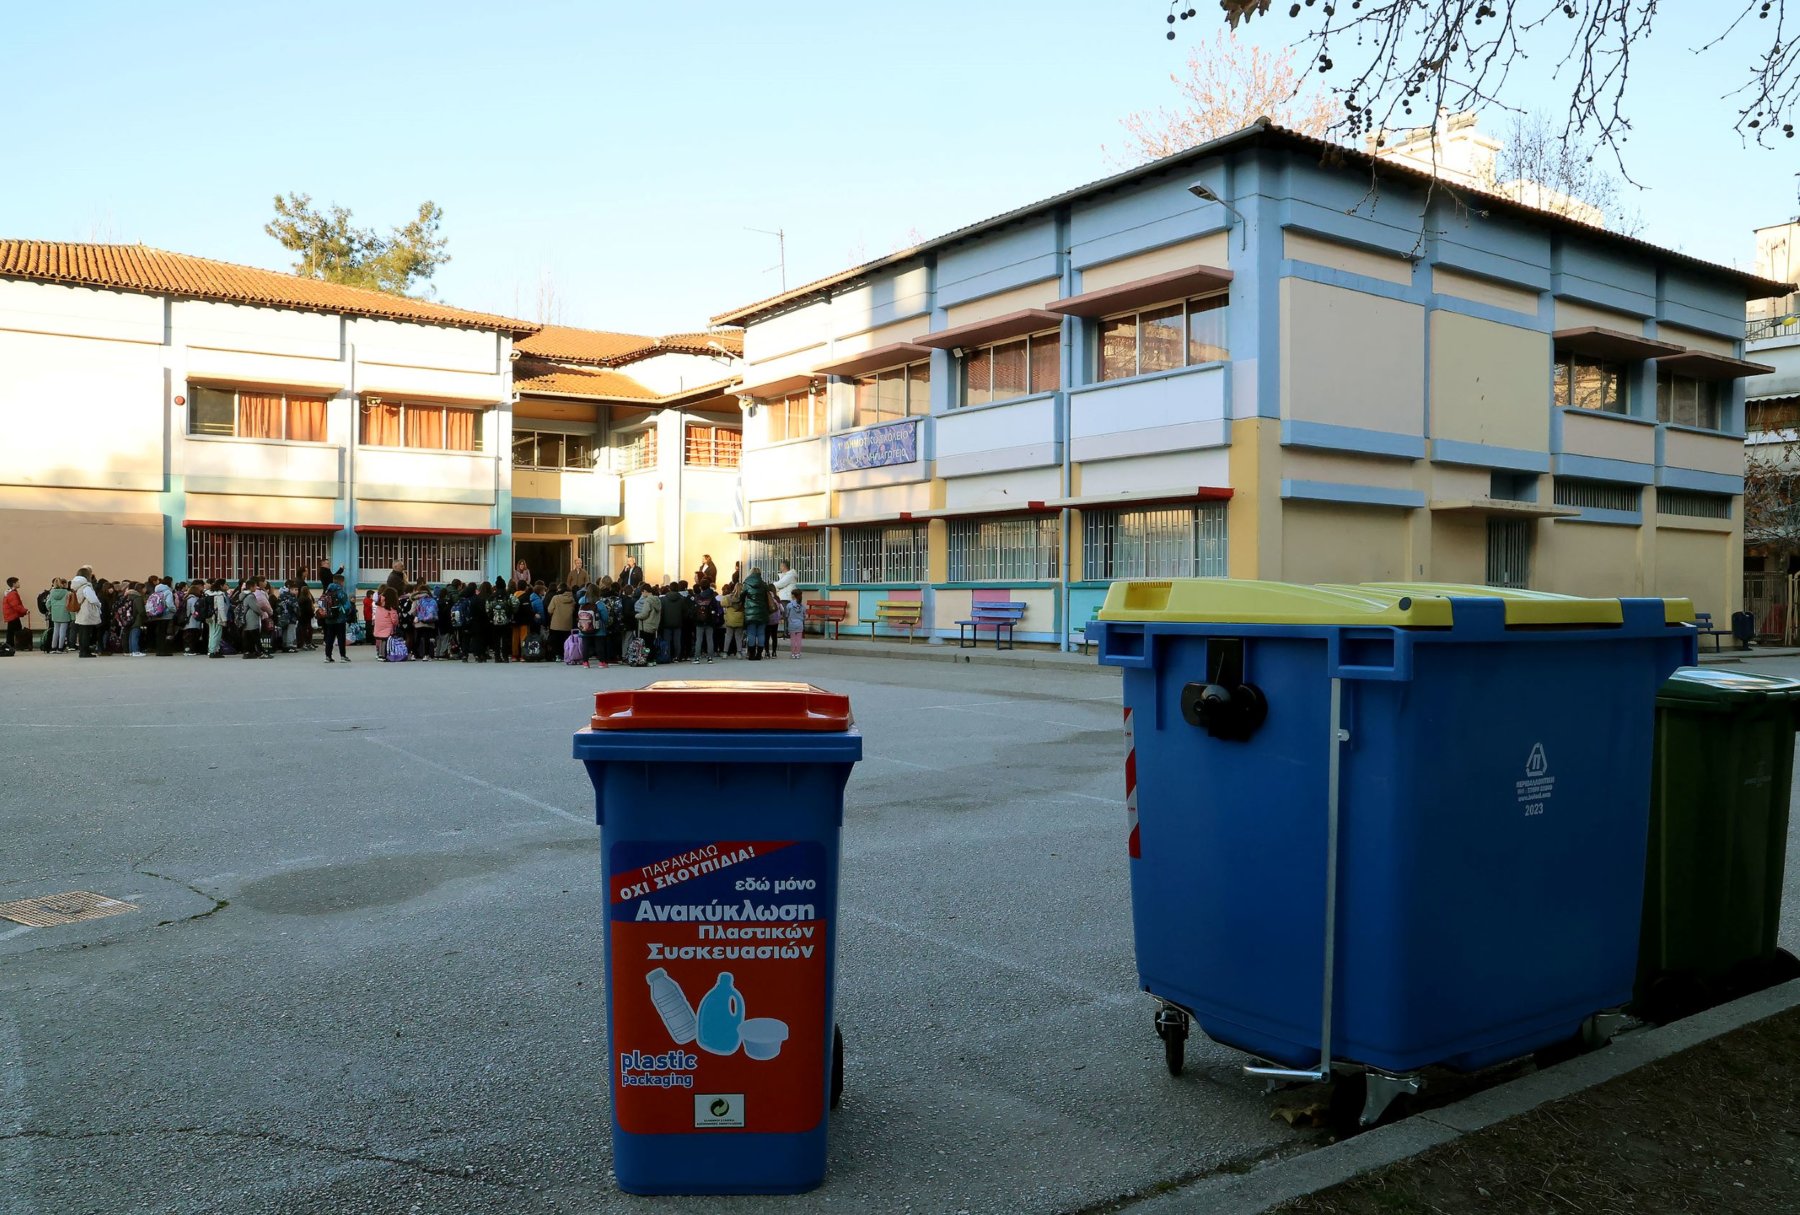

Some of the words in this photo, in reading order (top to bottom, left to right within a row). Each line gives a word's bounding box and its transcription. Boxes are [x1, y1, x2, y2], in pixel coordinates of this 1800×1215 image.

[1525, 802, 1544, 816] 2023
[642, 844, 719, 878] ΠΑΡΑΚΑΛΩ
[620, 881, 650, 900] ΟΧΙ
[653, 846, 755, 889] ΣΚΟΥΠΙΔΙΑ!
[735, 877, 770, 891] εδώ
[774, 876, 816, 894] μόνο
[635, 899, 815, 922] Ανακύκλωση
[698, 924, 815, 940] Πλαστικών
[647, 941, 815, 960] Συσκευασιών
[621, 1050, 698, 1073] plastic
[622, 1072, 693, 1088] packaging
